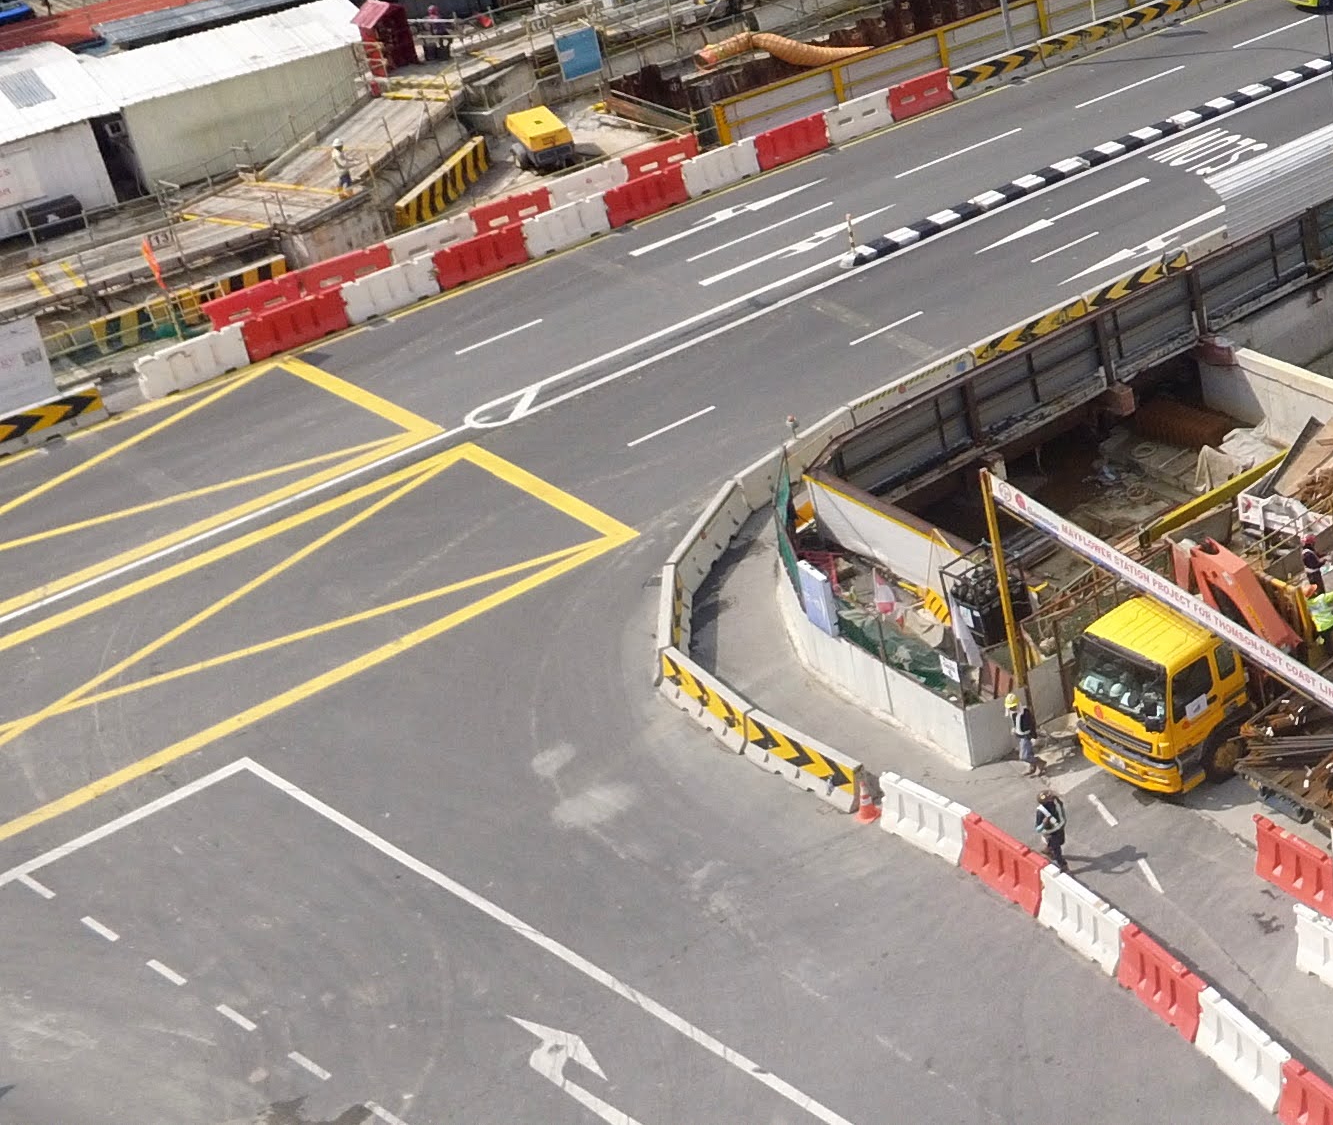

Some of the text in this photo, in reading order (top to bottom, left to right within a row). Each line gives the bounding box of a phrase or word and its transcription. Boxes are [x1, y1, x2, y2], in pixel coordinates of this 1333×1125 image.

[1147, 127, 1268, 175] SLOW
[1060, 523, 1114, 560] MAYFLOWER
[1114, 556, 1150, 585] STATION
[1152, 578, 1191, 608] PROJECT
[1193, 602, 1212, 622] FOR
[1285, 661, 1317, 687] COAST
